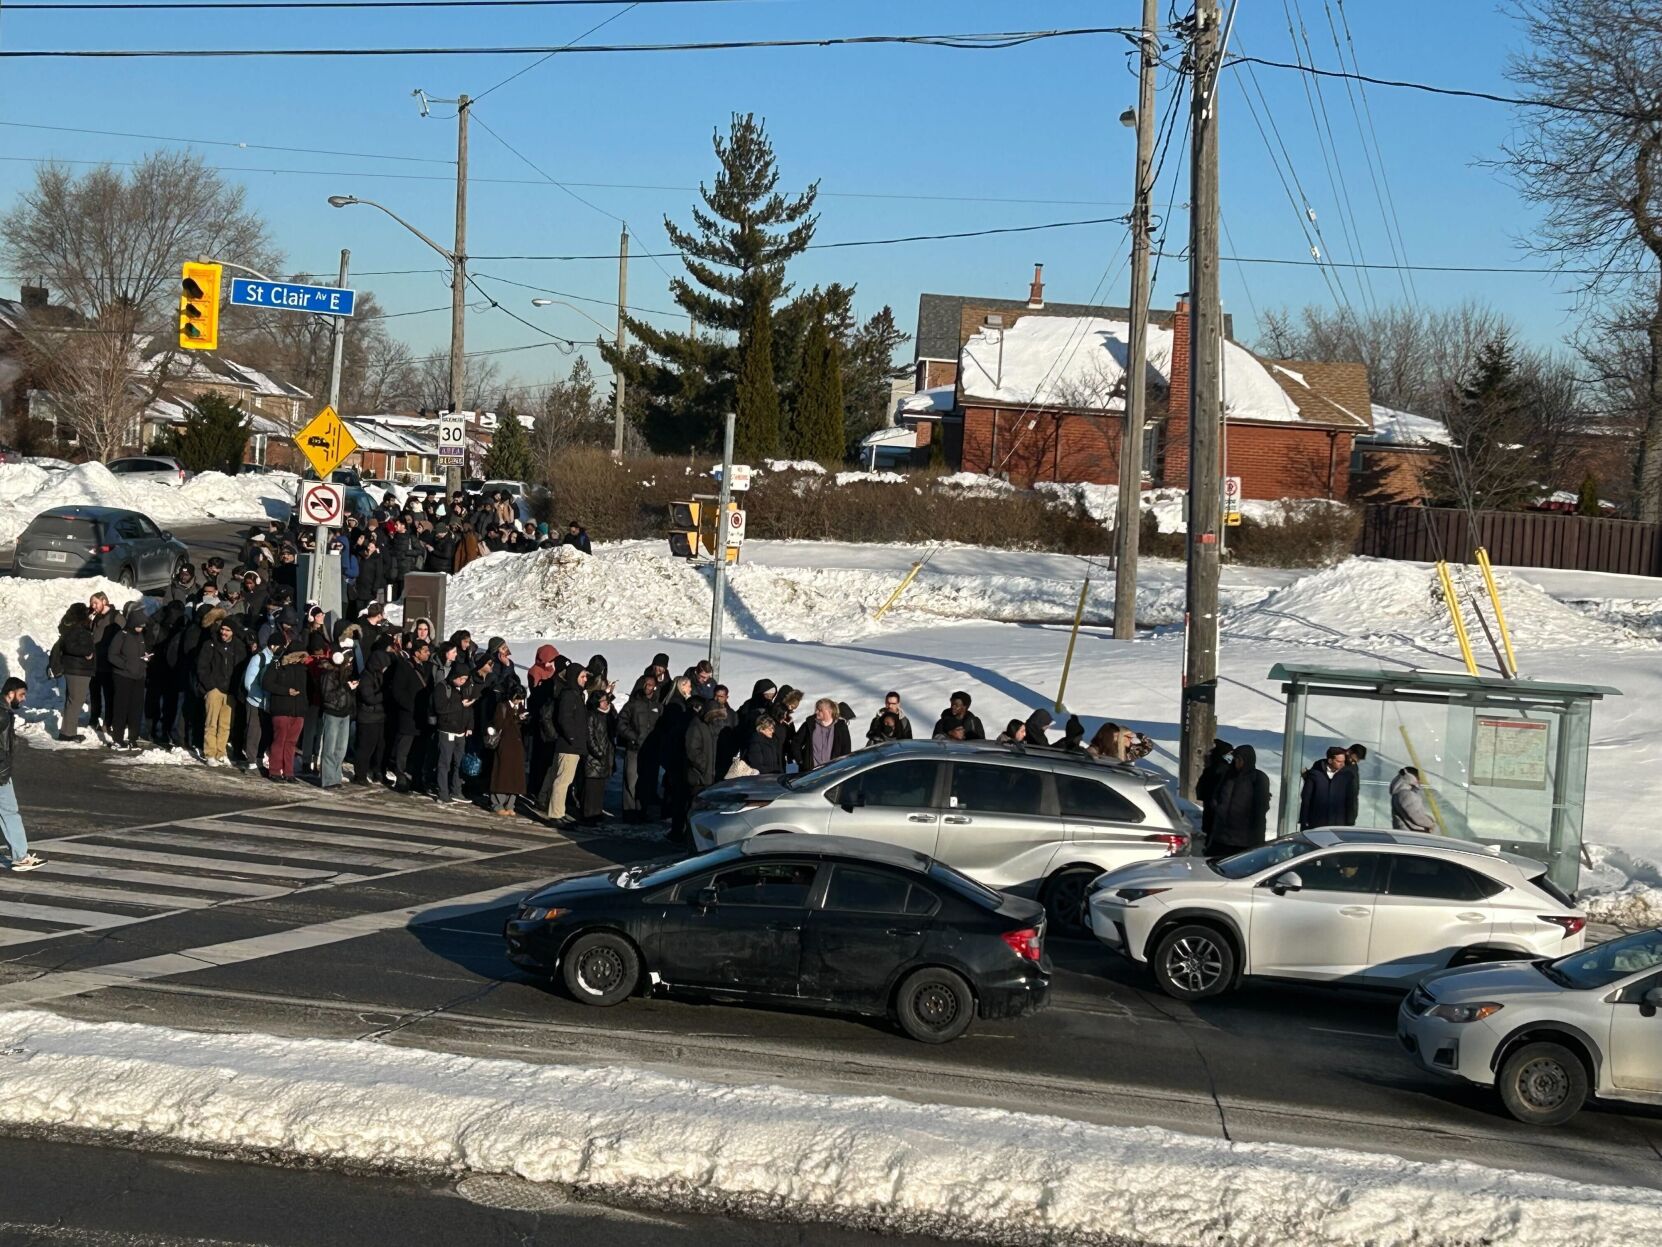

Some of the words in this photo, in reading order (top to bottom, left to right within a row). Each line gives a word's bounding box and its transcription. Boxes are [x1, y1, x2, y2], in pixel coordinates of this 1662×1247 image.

[246, 284, 264, 302] St
[270, 287, 311, 306] Clair
[315, 291, 327, 301] Av
[329, 293, 340, 310] E
[442, 427, 462, 442] 30
